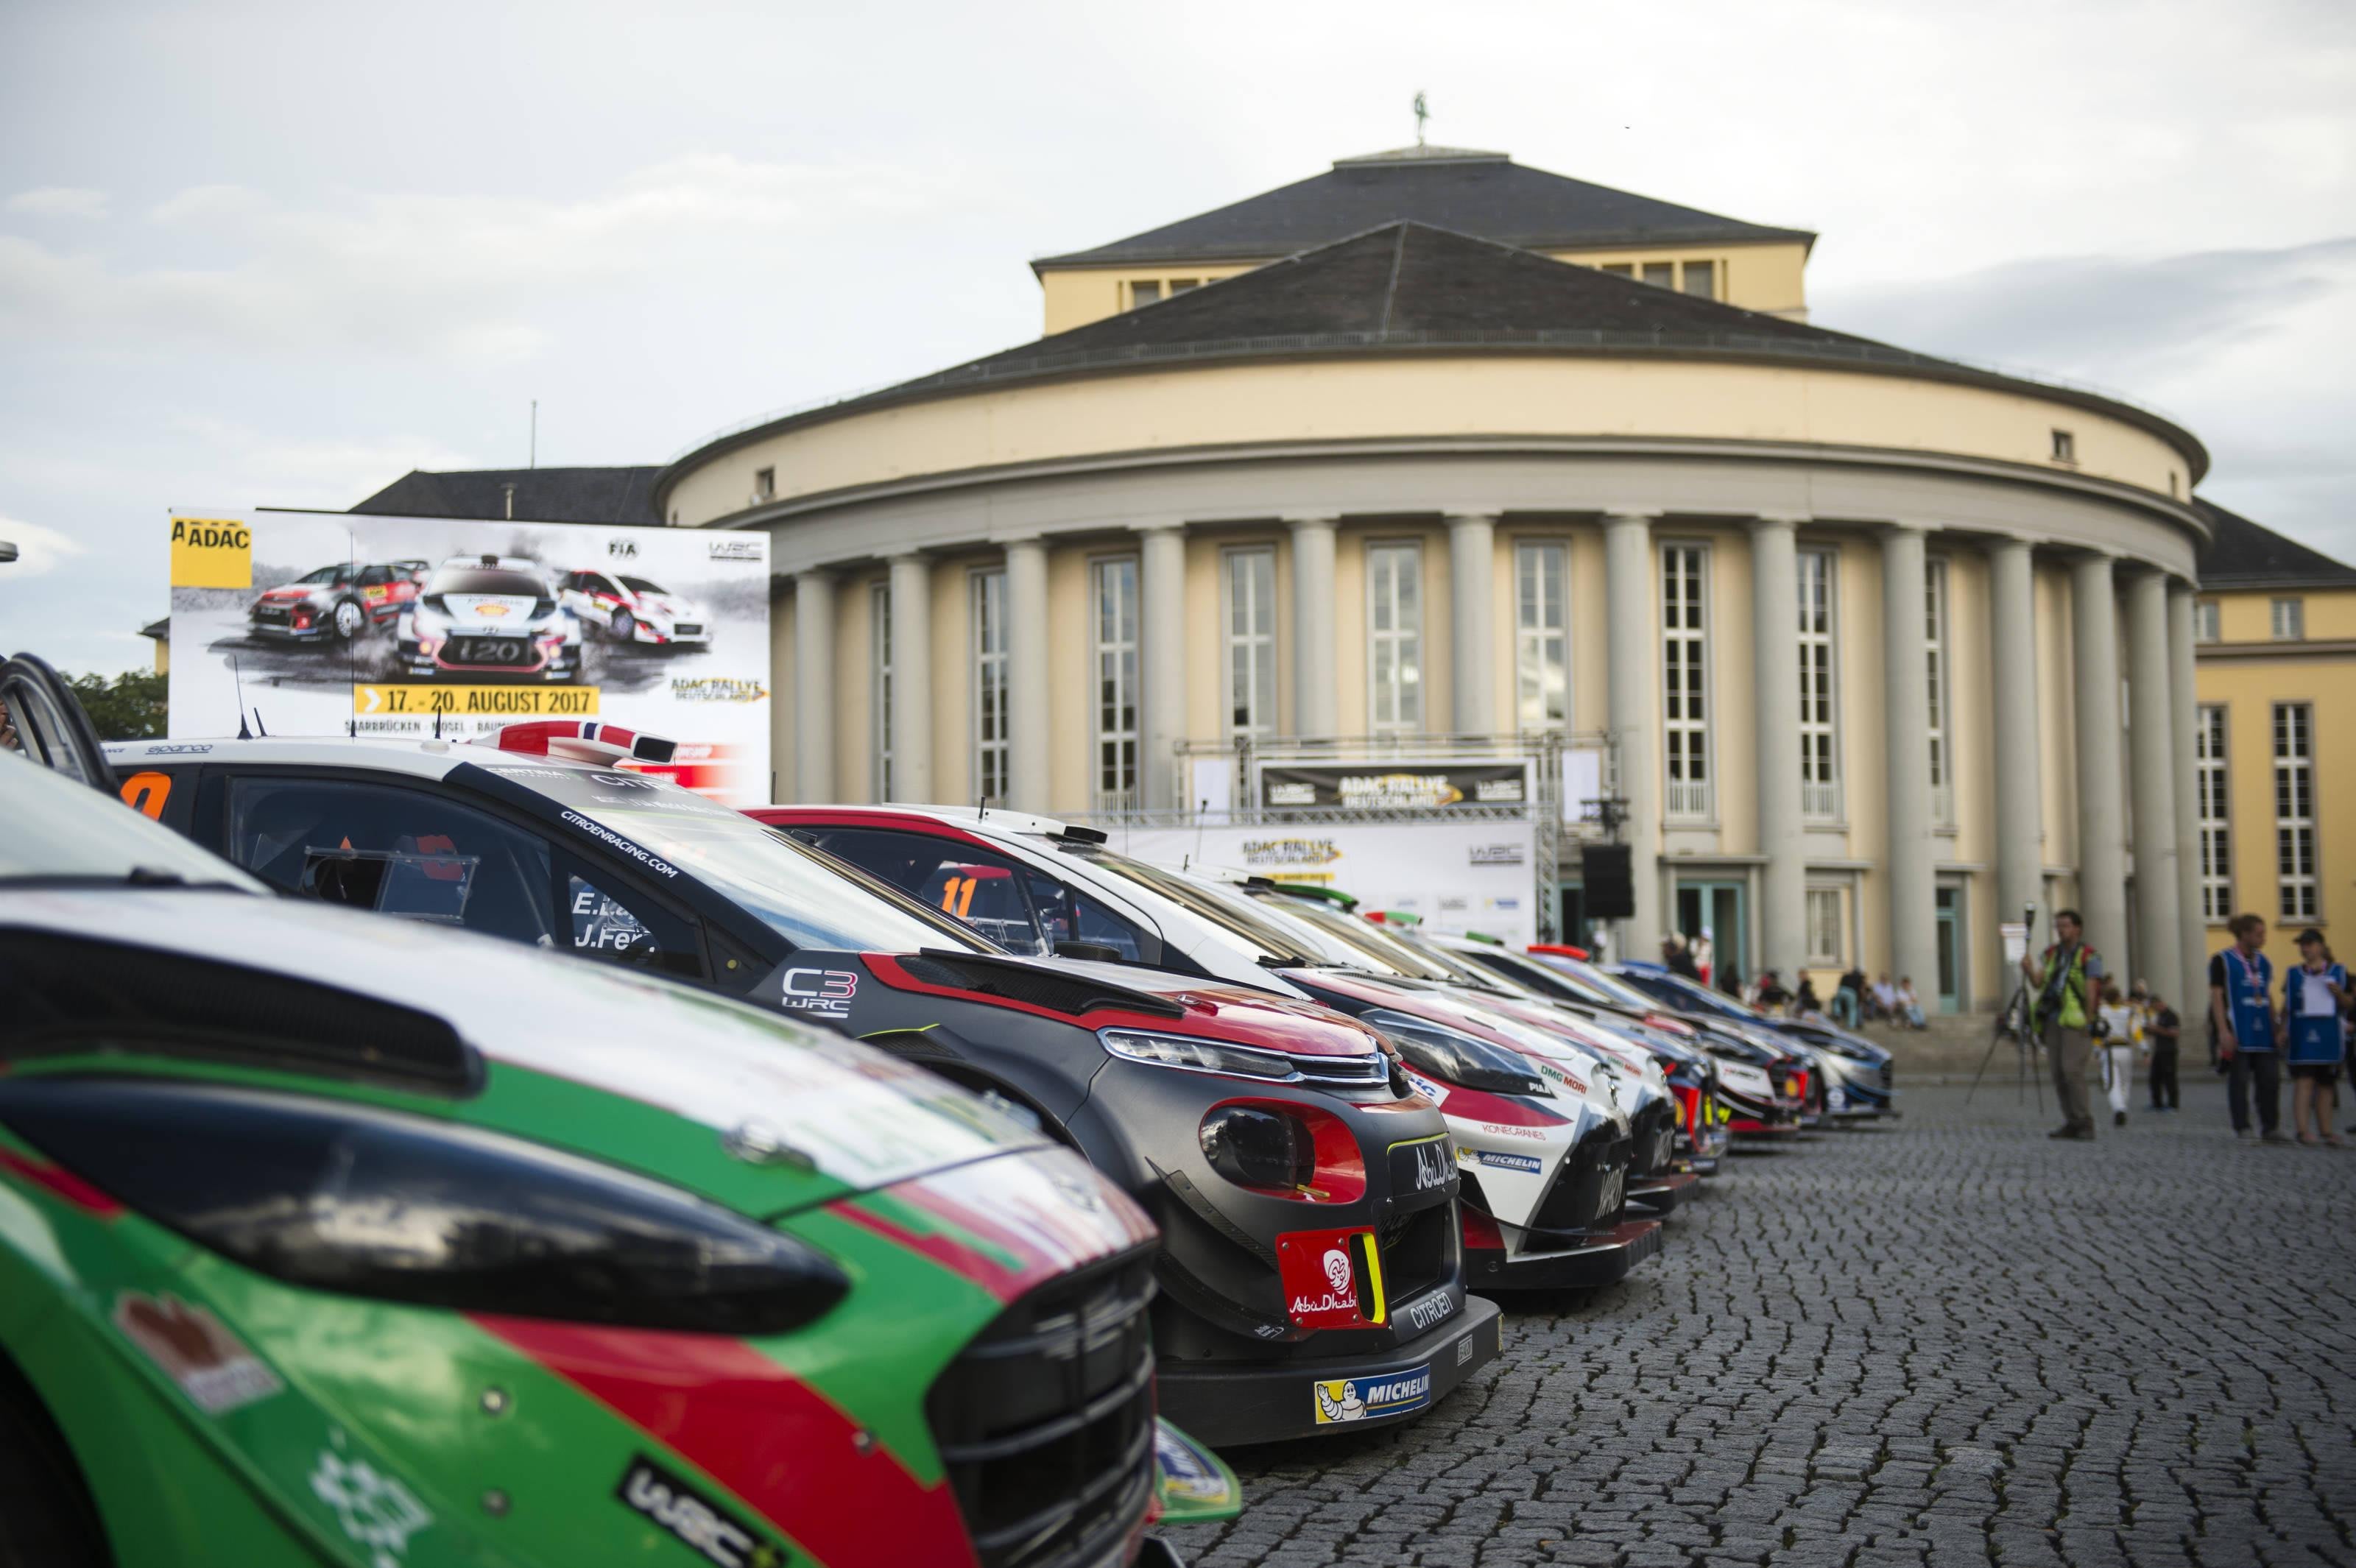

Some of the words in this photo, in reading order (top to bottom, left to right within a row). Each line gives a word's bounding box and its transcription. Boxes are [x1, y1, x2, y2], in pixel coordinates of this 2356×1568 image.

[188, 529, 249, 548] ADAC
[608, 543, 637, 556] FIA
[709, 542, 762, 557] WRC
[671, 679, 705, 690] ADAC
[387, 690, 413, 713] 17.
[430, 691, 461, 713] 20.
[467, 691, 542, 713] AUGUST
[548, 691, 591, 713] 2017
[147, 744, 214, 755] sparco
[1342, 794, 1436, 809] DEUTSCHLAND
[560, 811, 678, 878] CITROENRACING.COM
[1243, 841, 1276, 854] ADAC
[1470, 844, 1524, 861] WRC
[942, 877, 977, 918] 11
[782, 967, 858, 999] C3
[781, 996, 851, 1011] WRC
[1541, 1065, 1563, 1082] DMG
[1563, 1076, 1587, 1095] MORI
[1481, 1124, 1546, 1141] KONECRANES
[1483, 1154, 1541, 1170] MICHELIN
[1367, 1373, 1429, 1404] MICHELIN
